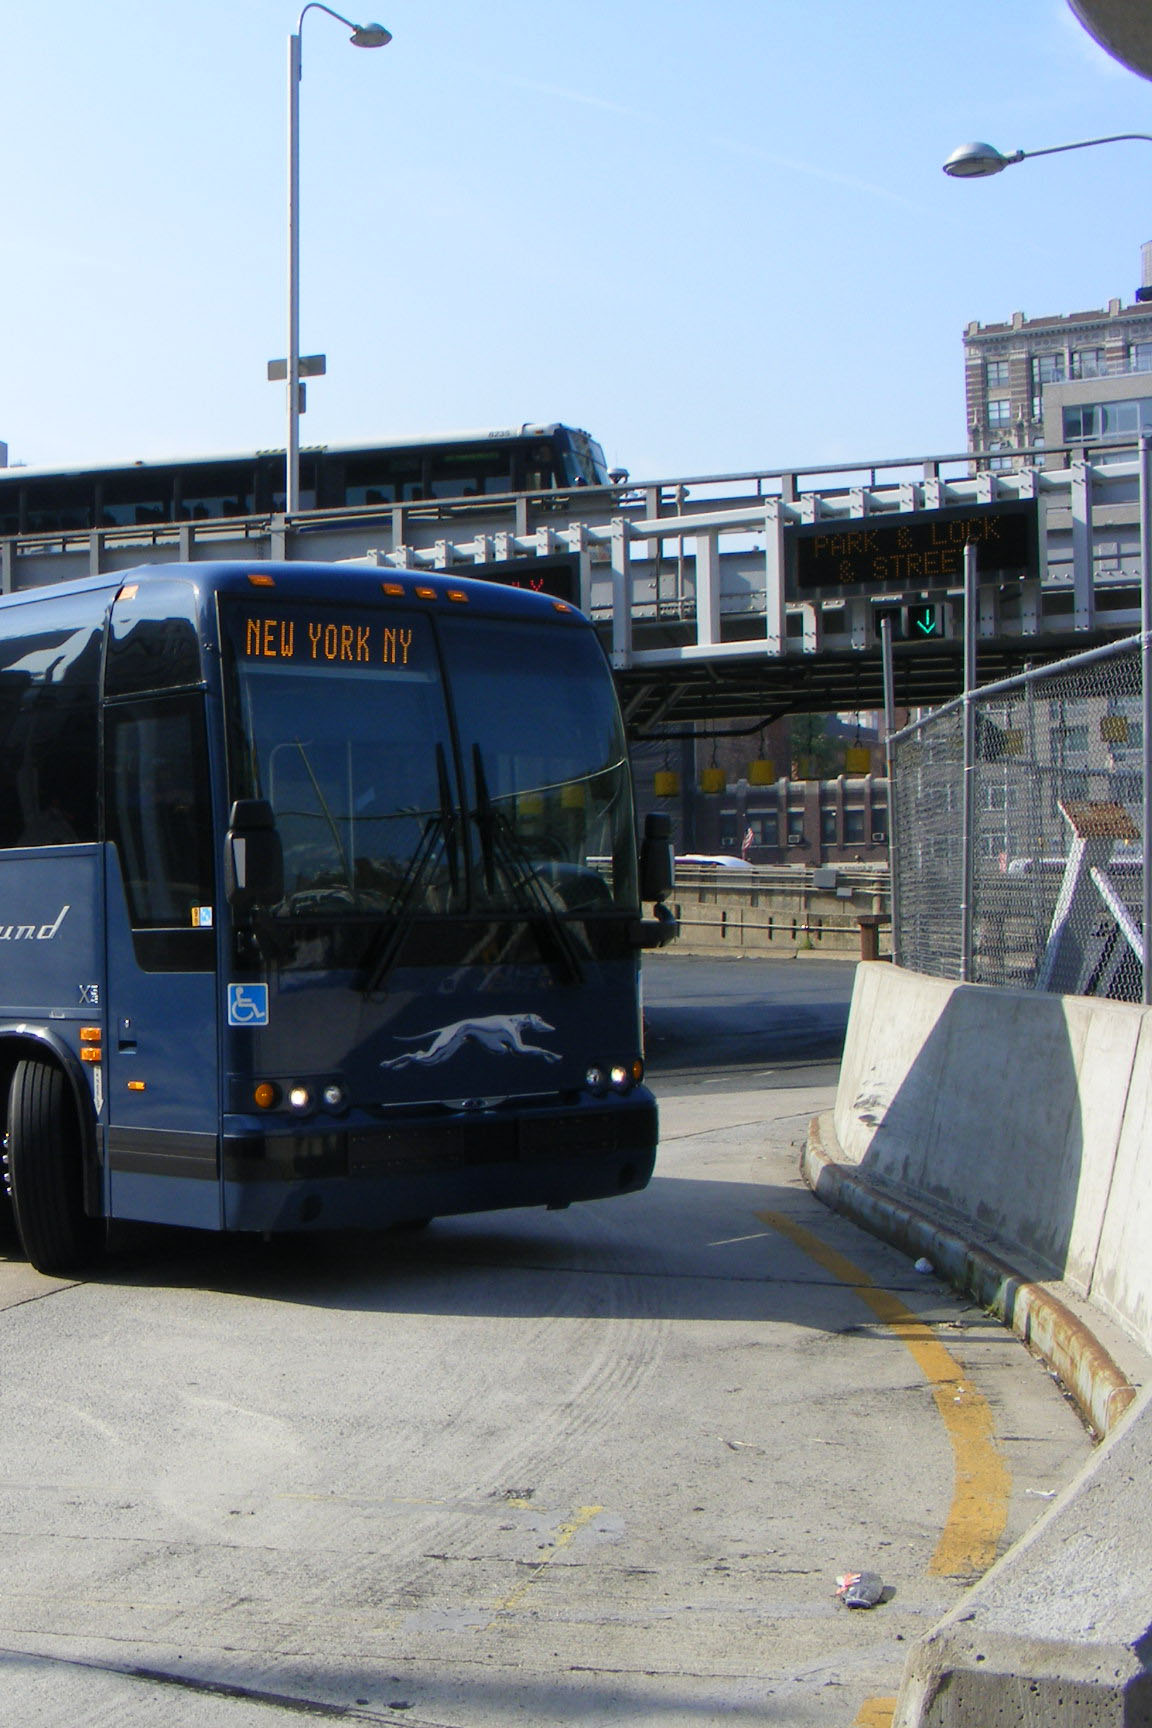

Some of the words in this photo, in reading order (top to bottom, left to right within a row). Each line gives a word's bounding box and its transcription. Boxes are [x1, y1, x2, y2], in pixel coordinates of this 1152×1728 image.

[813, 529, 879, 557] PARK
[897, 526, 913, 549] &
[931, 516, 1000, 546] LOCK
[839, 560, 855, 583] &
[873, 548, 962, 580] STREE
[246, 618, 294, 656] NEW
[309, 622, 370, 661] YORK
[383, 628, 412, 664] NY
